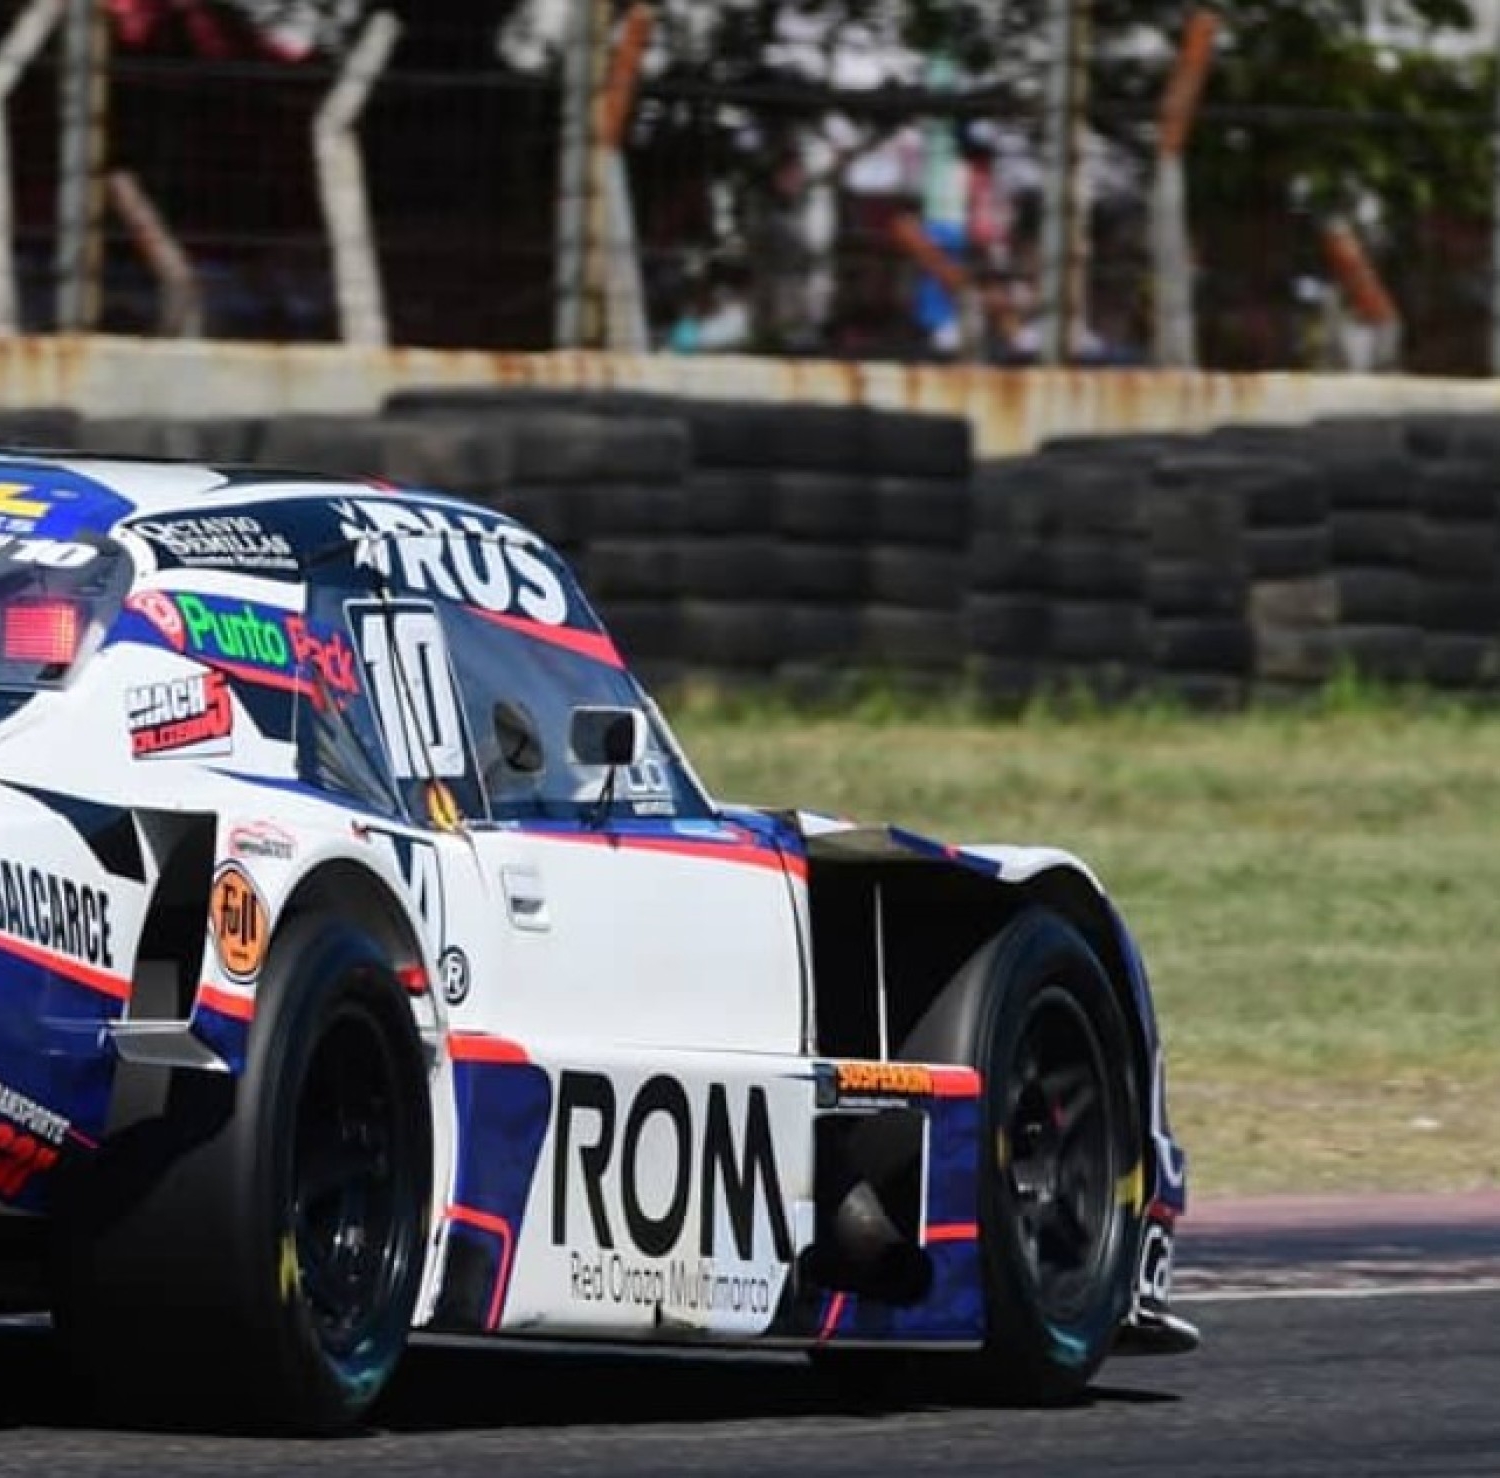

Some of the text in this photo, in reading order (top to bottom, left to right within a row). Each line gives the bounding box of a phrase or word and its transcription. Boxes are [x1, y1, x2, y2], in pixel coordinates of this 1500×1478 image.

[10, 538, 100, 568] 10
[177, 592, 289, 667] Punto
[127, 674, 205, 730] MACH
[362, 613, 466, 777] 10
[552, 1070, 792, 1262] ROM
[570, 1249, 604, 1303] Red
[669, 1258, 770, 1314] Multimarca
